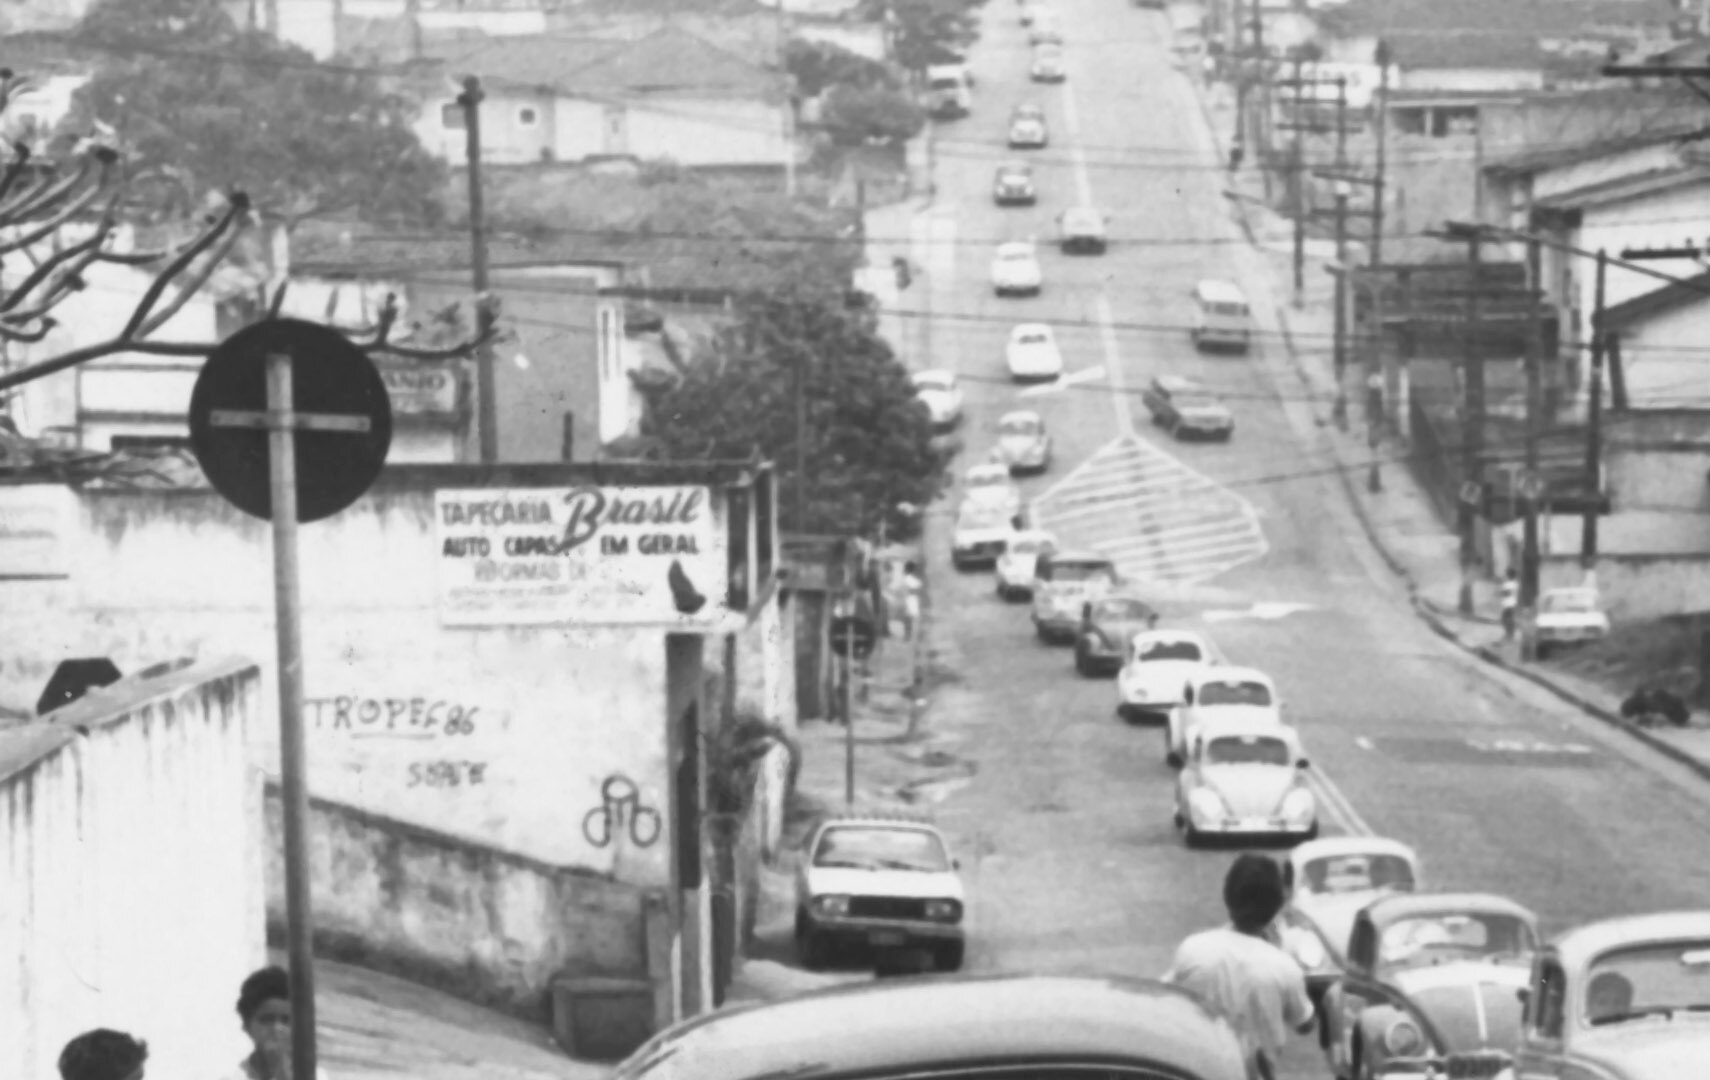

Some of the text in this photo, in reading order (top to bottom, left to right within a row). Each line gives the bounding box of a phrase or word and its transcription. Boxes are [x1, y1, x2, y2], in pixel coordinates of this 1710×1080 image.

[555, 485, 701, 554] Brasil
[442, 535, 491, 557] AUTO
[600, 534, 628, 555] EM
[637, 533, 700, 555] GERAL
